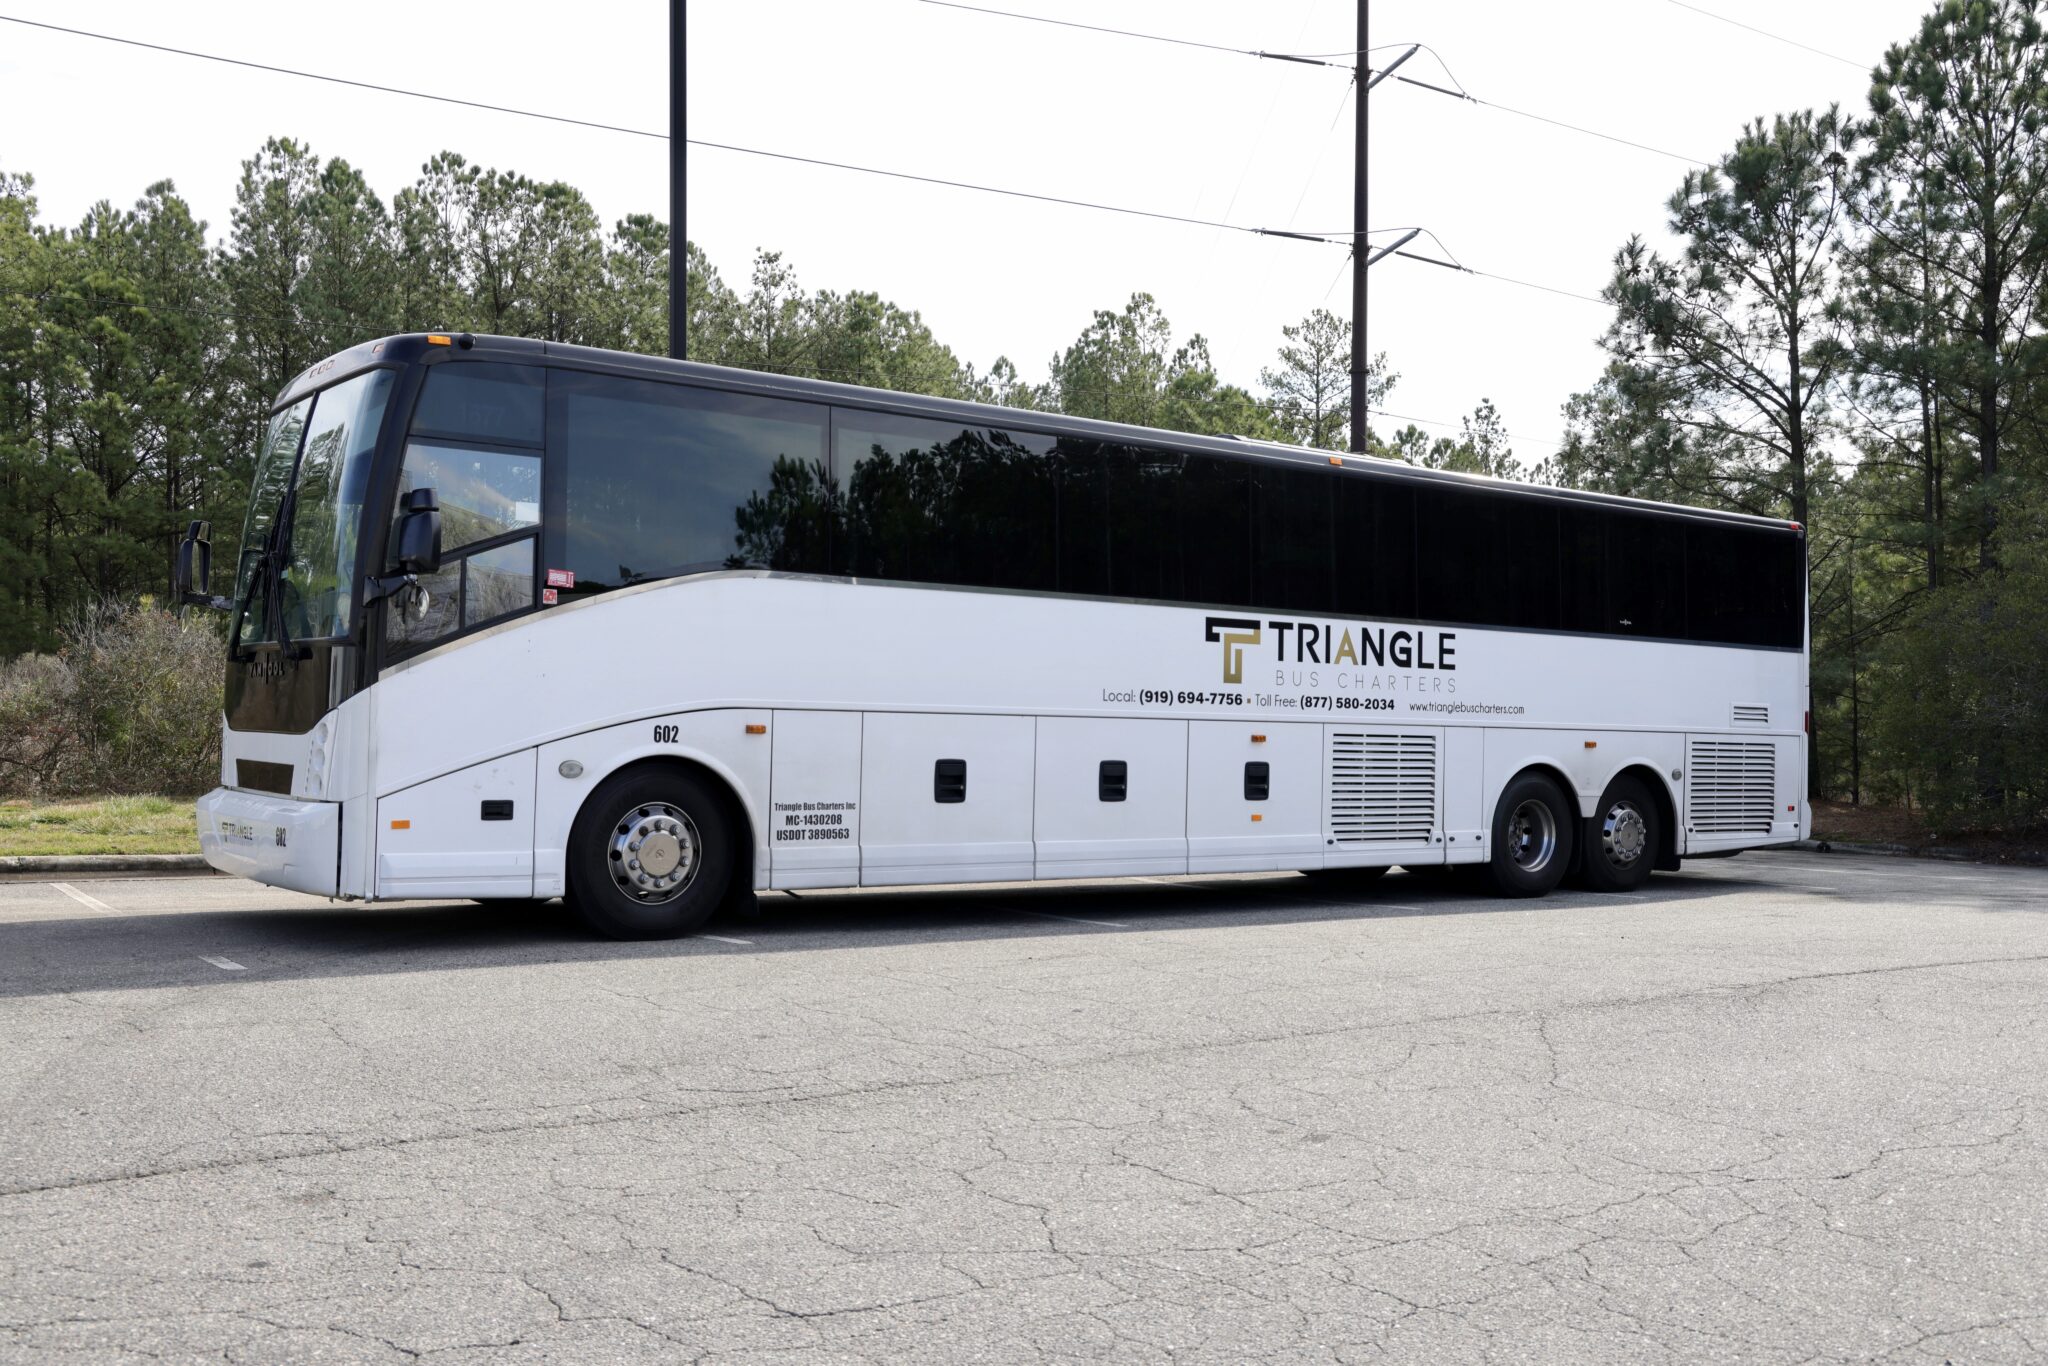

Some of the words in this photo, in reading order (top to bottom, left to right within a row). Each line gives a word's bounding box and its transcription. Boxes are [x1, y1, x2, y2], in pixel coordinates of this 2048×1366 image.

[1268, 621, 1456, 670] TRIANGLE
[1275, 669, 1319, 687] BUS
[1337, 672, 1456, 693] CHARTERS
[1102, 688, 1136, 702] Local:
[1139, 689, 1174, 706] (919)
[1177, 691, 1243, 705] 694-7756
[1255, 694, 1272, 706] Toll
[1274, 694, 1298, 708] Free:
[1300, 695, 1333, 711] (877)
[1336, 697, 1395, 710] 580-2034
[1409, 701, 1525, 715] www.trianglebuscharters.com
[653, 725, 679, 743] 602
[774, 803, 802, 812] Triangle
[803, 802, 816, 811] Bus
[816, 802, 845, 810] Charters
[846, 802, 856, 810] Inc
[785, 814, 843, 826] MC-1430208
[776, 829, 806, 841] USDOT
[808, 828, 850, 840] 3890563
